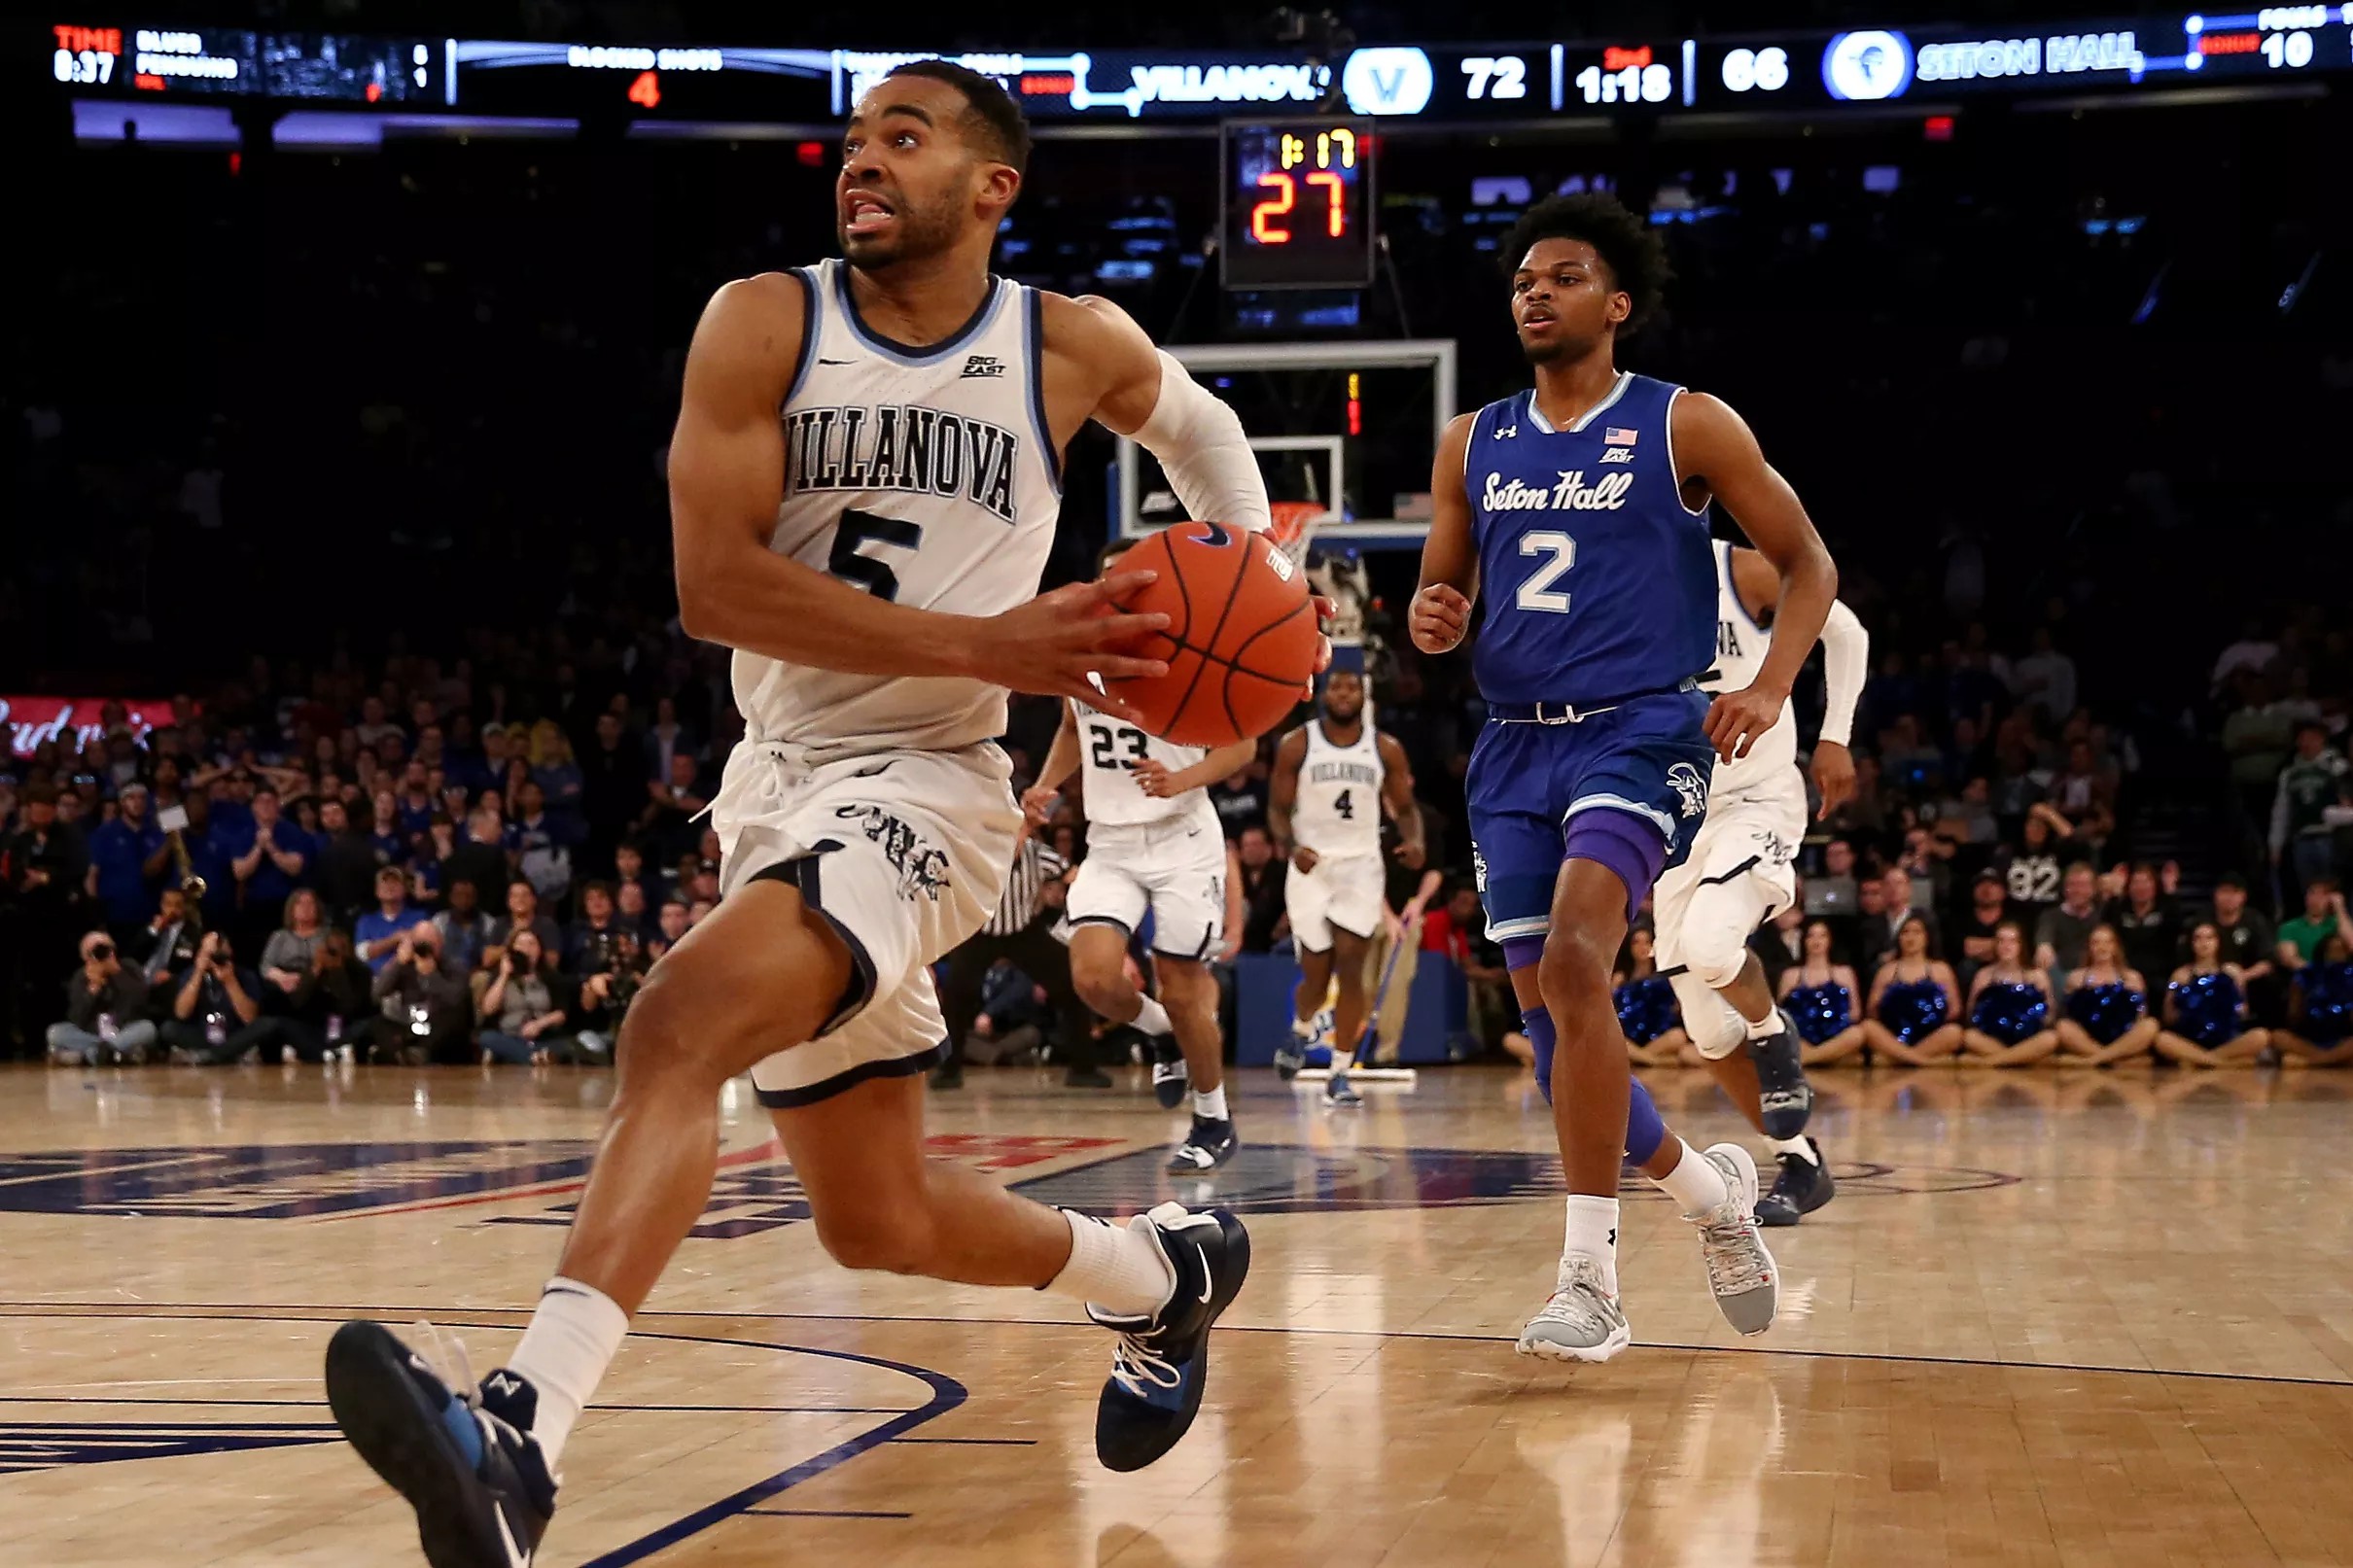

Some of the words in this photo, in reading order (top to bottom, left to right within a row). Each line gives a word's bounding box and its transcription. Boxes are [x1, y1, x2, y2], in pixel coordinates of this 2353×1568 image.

[53, 25, 123, 55] TIME
[2046, 31, 2139, 74] HALL
[2261, 30, 2314, 68] 10
[627, 70, 662, 109] 4
[1460, 55, 1526, 99] 72
[1575, 63, 1672, 104] 1:18
[1722, 47, 1789, 91] 66
[1281, 127, 1355, 170] 1:17
[1251, 170, 1345, 245] 27
[962, 364, 1007, 375] EAST
[966, 355, 999, 366] BIG
[1483, 471, 1549, 512] Seton
[1551, 470, 1634, 511] Hall
[828, 506, 925, 605] 5
[1515, 529, 1577, 614] 2
[1089, 723, 1150, 770] 23
[1333, 787, 1354, 819] 4
